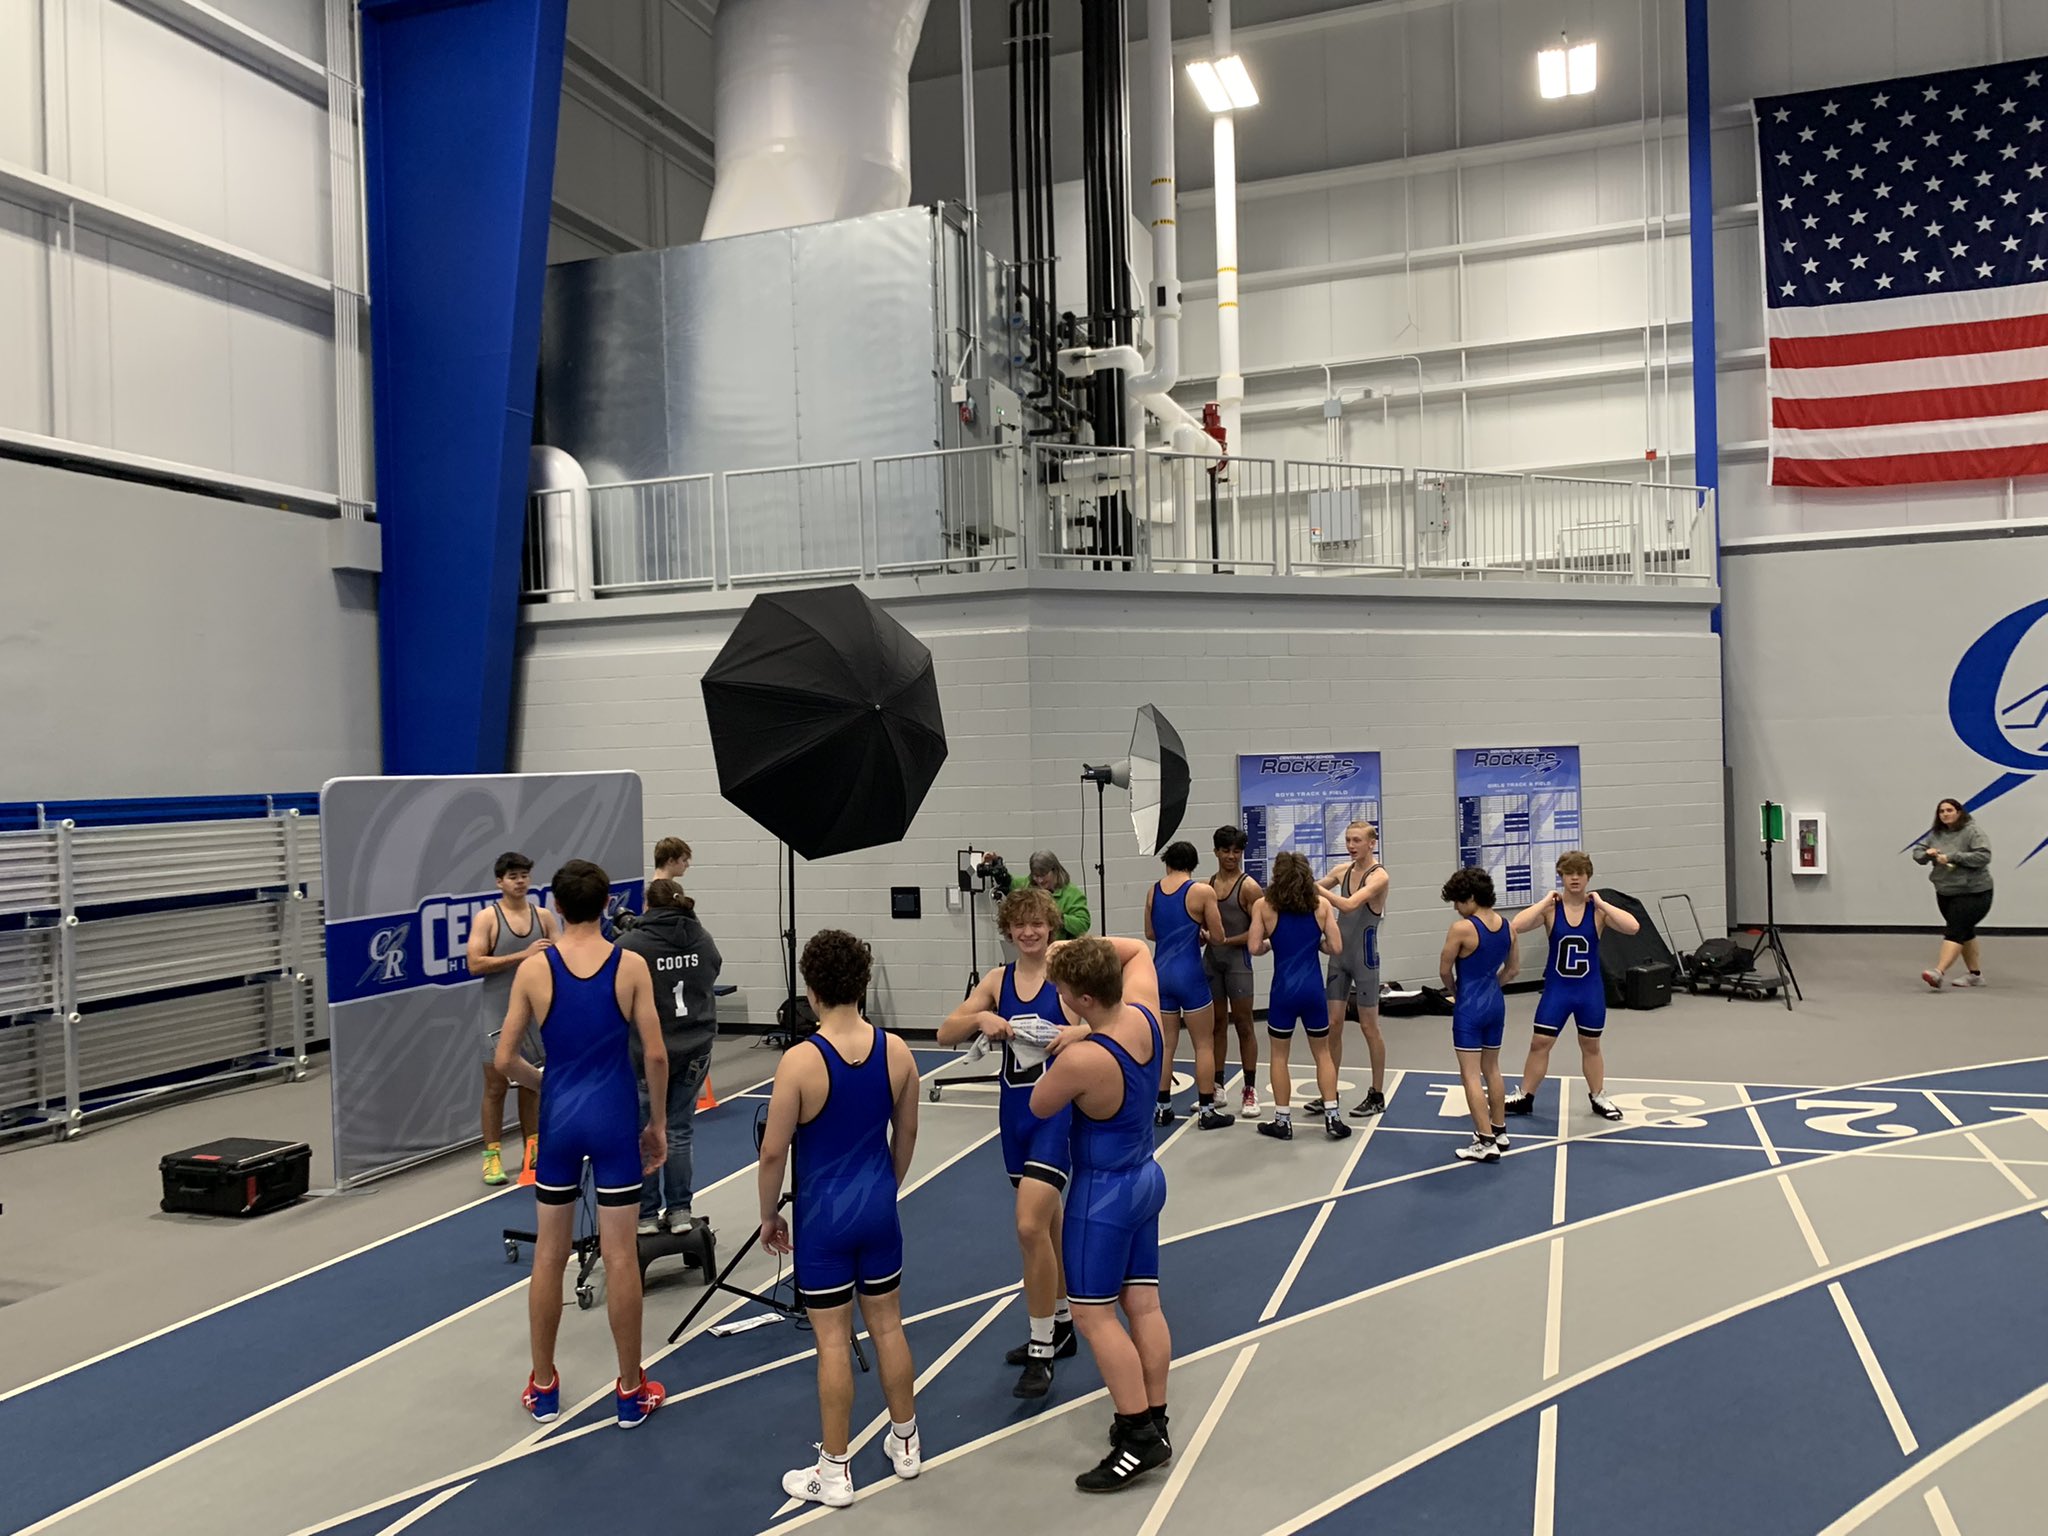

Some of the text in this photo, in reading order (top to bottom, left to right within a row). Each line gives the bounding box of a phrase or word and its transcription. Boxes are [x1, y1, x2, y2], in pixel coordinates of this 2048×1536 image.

[1260, 757, 1355, 775] ROCKETS
[1473, 751, 1557, 768] ROCKETS
[656, 953, 699, 971] COOTS
[1555, 935, 1590, 979] C
[672, 980, 688, 1018] 1
[1606, 1092, 1708, 1129] 3
[1796, 1099, 1918, 1138] 2
